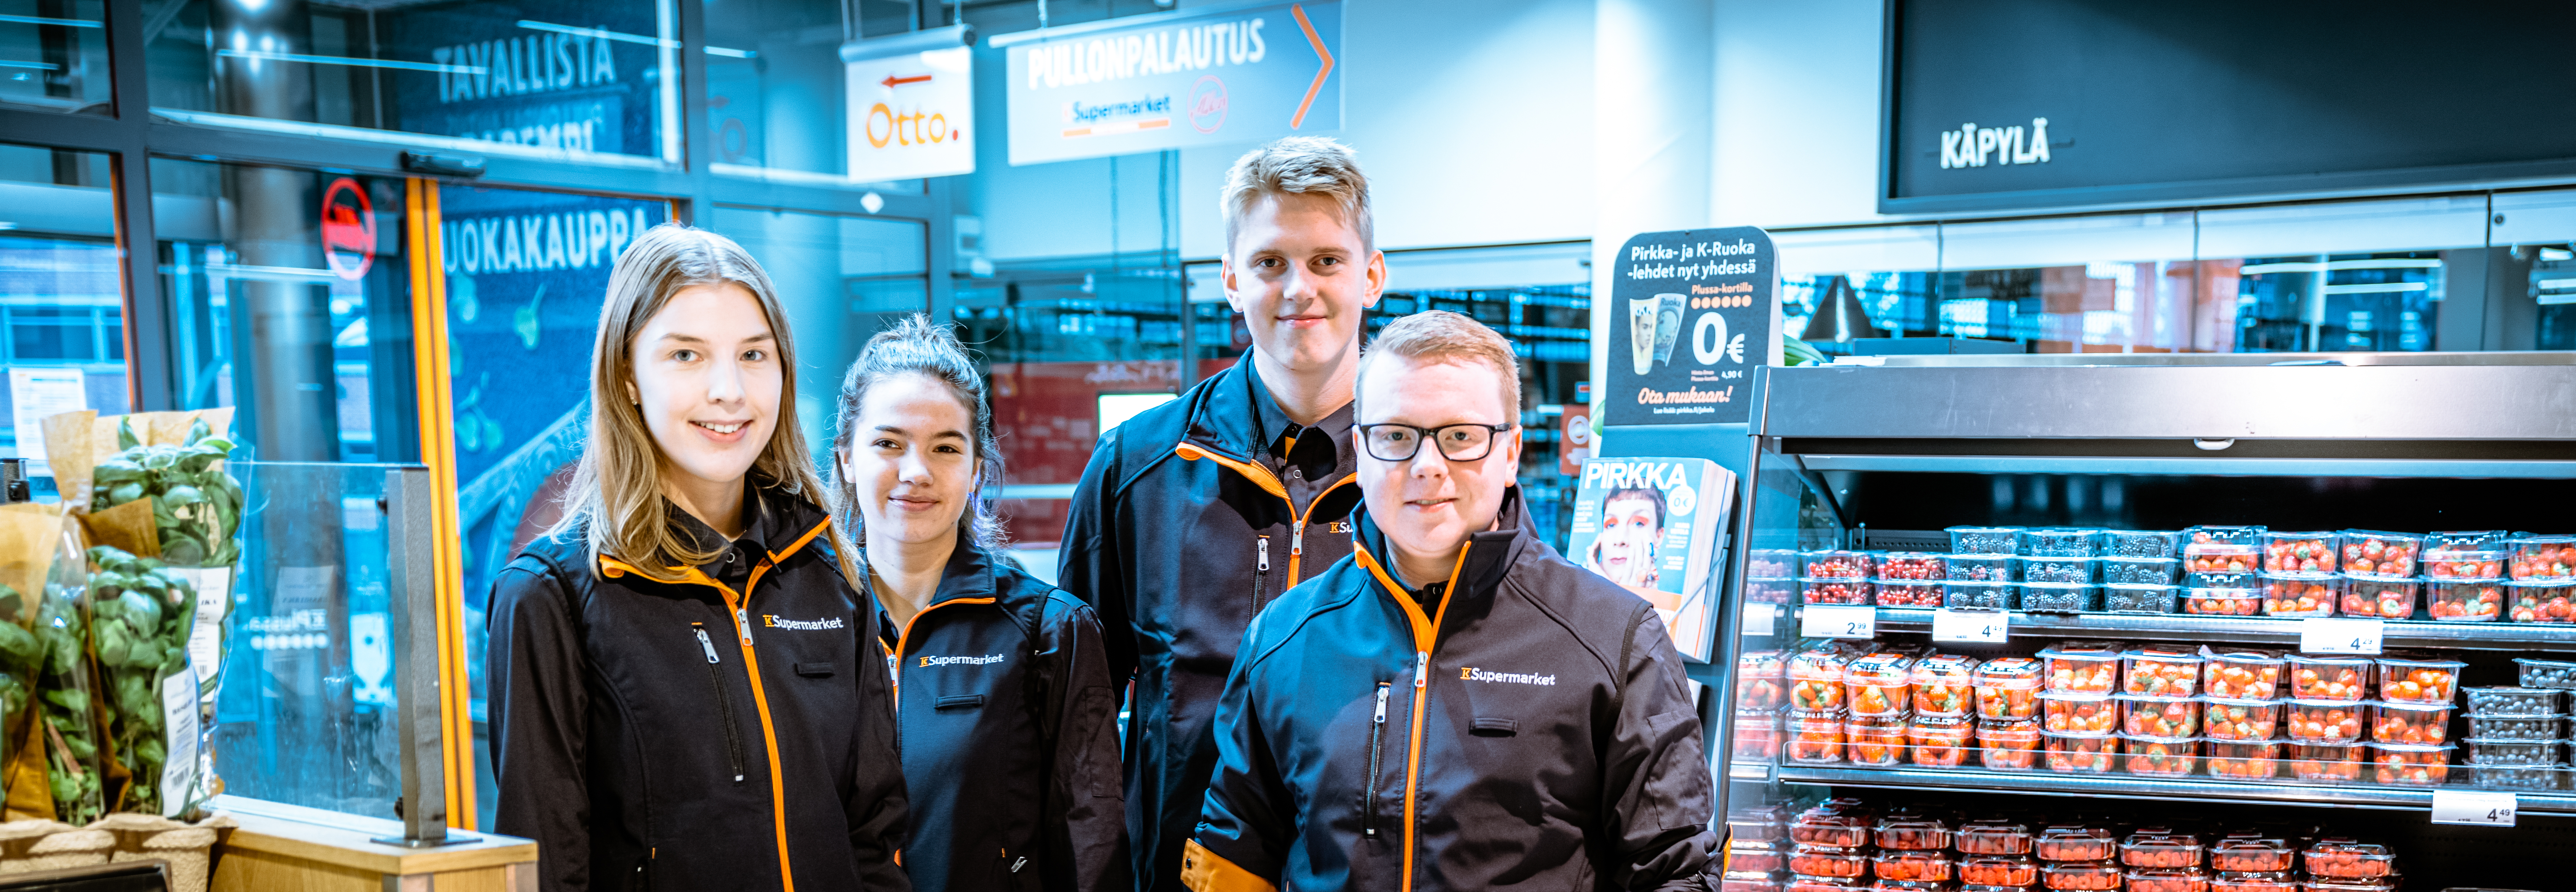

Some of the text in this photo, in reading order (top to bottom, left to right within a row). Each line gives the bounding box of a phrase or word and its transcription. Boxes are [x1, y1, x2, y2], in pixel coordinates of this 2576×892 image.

[433, 25, 616, 104] TAVALLISTA
[1028, 18, 1267, 91] PULLONPALAUTUS
[1072, 94, 1171, 123] Supermarket
[1941, 117, 2050, 169] KÄPYLÄ
[1631, 238, 1755, 262] Pirkka- ja K-Ruoka
[1627, 259, 1756, 281] -lehdet nyt yhdessä
[1691, 282, 1753, 295] Plussa-kortilla
[1721, 370, 1737, 379] 4,90
[1638, 385, 1734, 405] Ota mukaan!
[1585, 462, 1688, 489] PIRKKA
